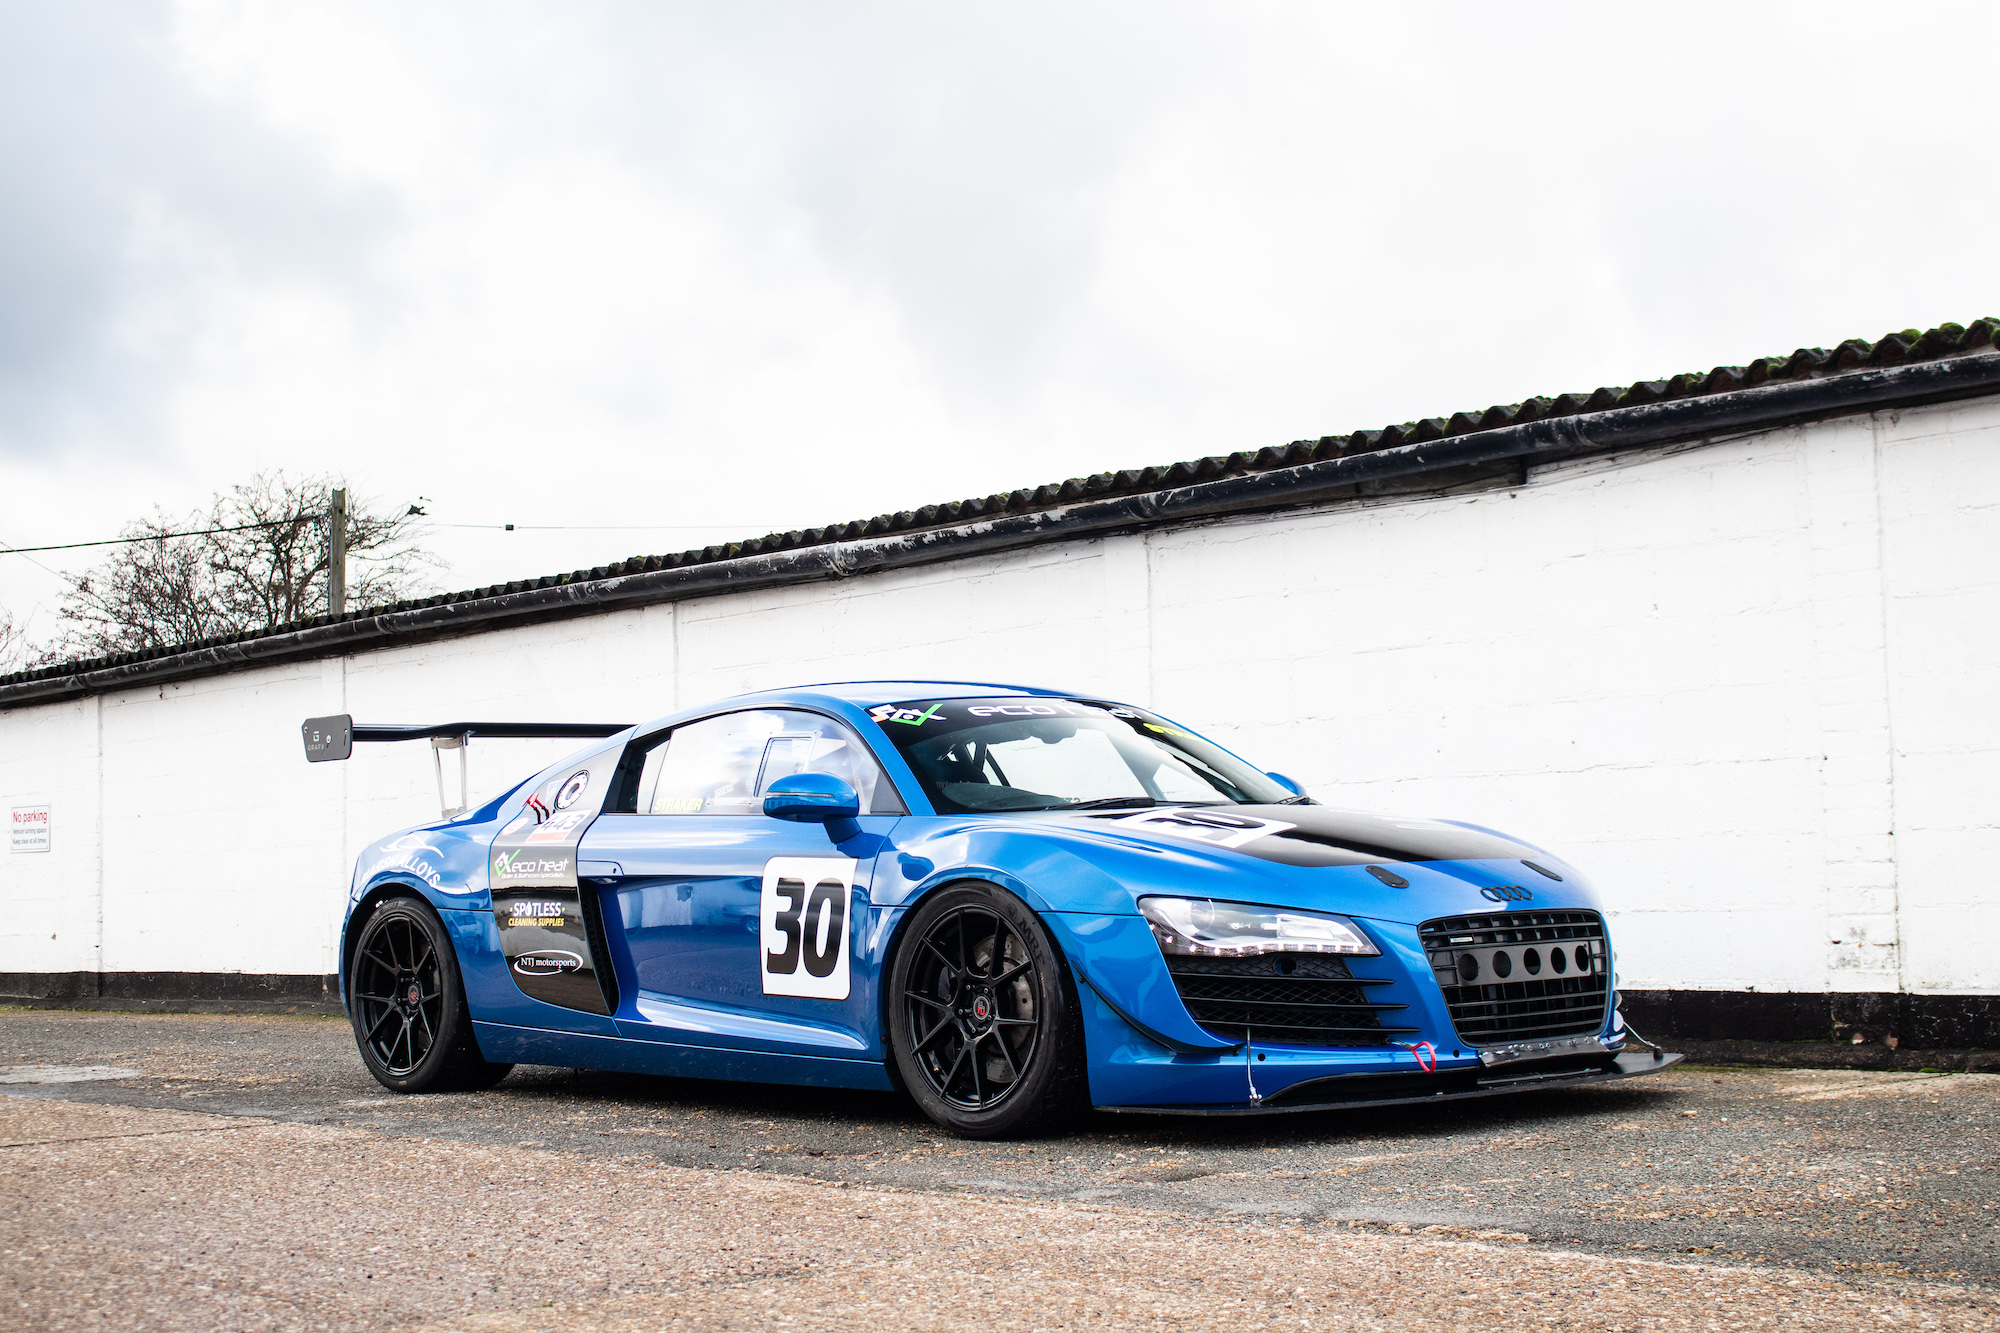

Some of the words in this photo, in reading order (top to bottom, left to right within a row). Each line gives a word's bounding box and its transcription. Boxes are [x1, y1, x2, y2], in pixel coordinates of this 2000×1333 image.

[966, 704, 1057, 718] eco
[307, 743, 325, 752] GRAFX
[654, 797, 704, 812] STRAKER
[12, 811, 22, 823] No
[23, 809, 48, 825] parking
[540, 813, 586, 831] 443
[1138, 811, 1266, 842] 30
[511, 861, 536, 873] eco
[537, 858, 570, 872] heat
[513, 901, 562, 917] SPOTLESS
[508, 917, 537, 927] CLEANING
[538, 917, 565, 927] SUPPLIES
[766, 877, 846, 978] 30
[521, 957, 535, 968] NTJ
[535, 958, 577, 969] motorsports
